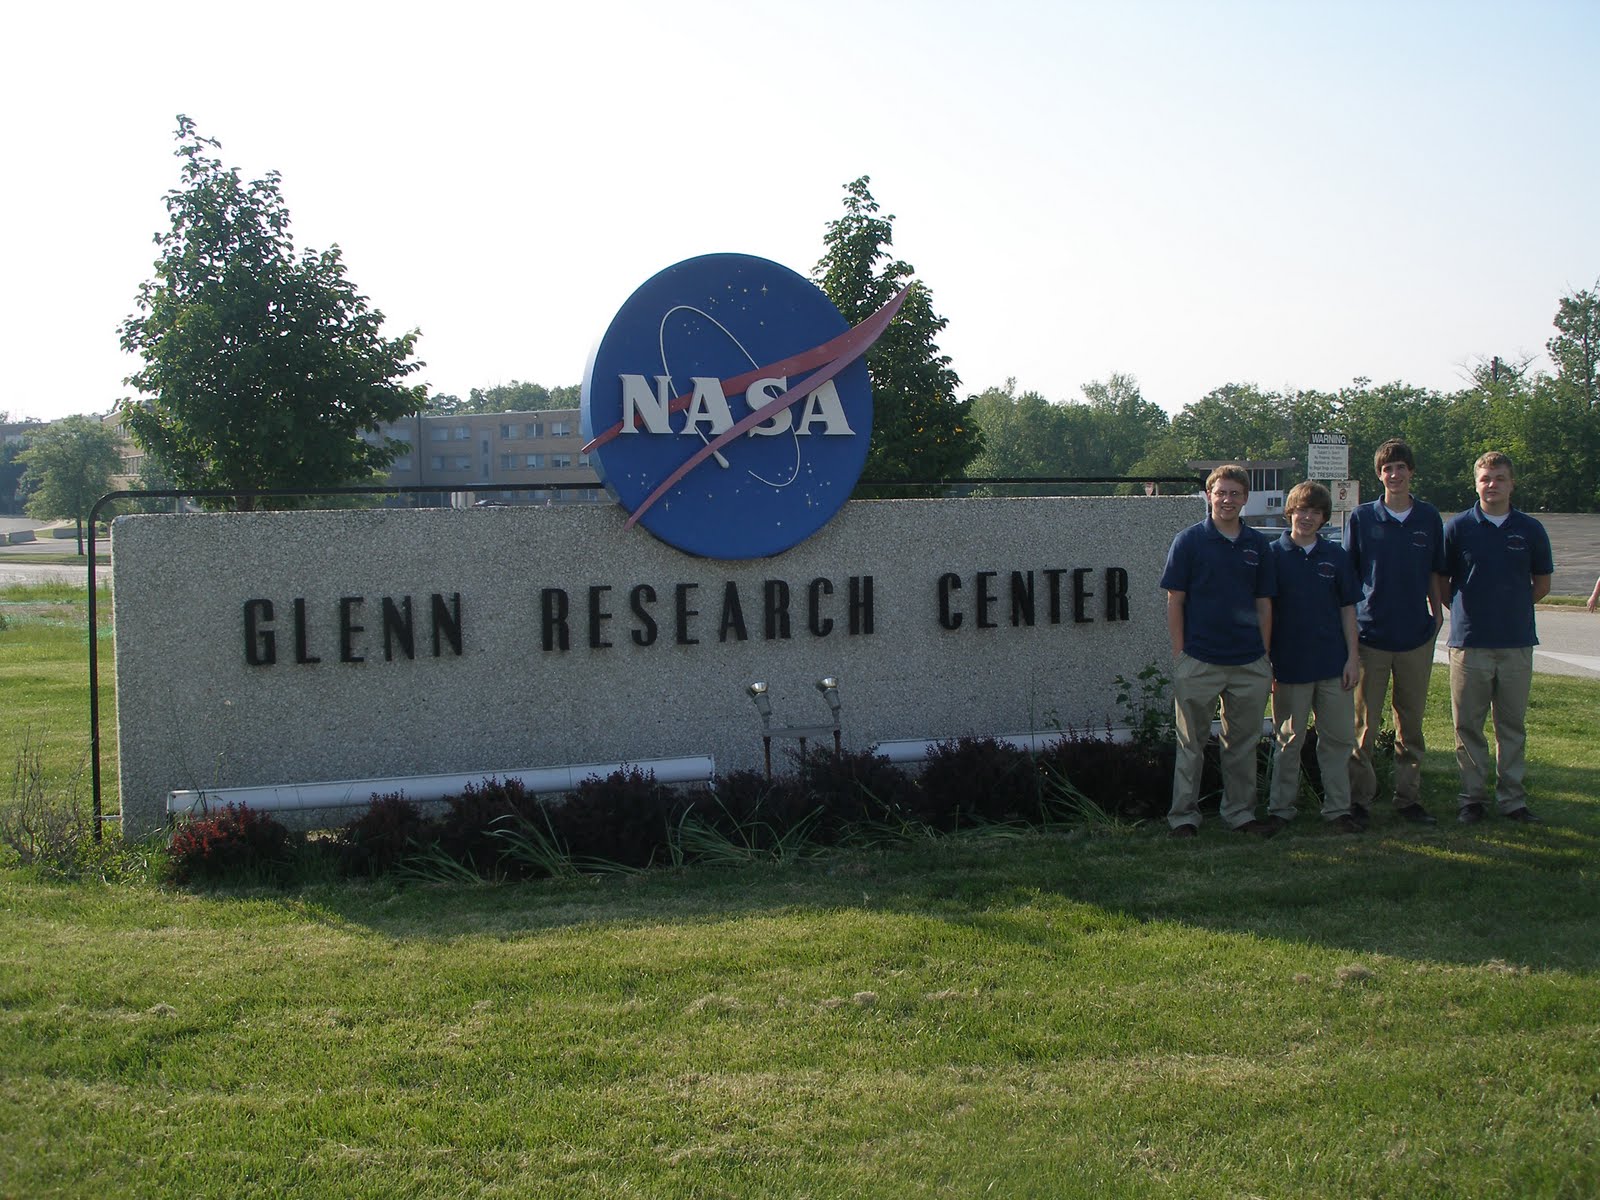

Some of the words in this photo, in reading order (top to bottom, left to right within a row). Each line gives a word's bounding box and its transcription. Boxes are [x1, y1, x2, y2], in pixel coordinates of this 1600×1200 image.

[618, 374, 856, 437] NASA
[1311, 433, 1347, 444] WARNING
[243, 592, 462, 666] GLENN
[541, 576, 874, 651] RESEARCH
[938, 567, 1130, 630] CENTER
